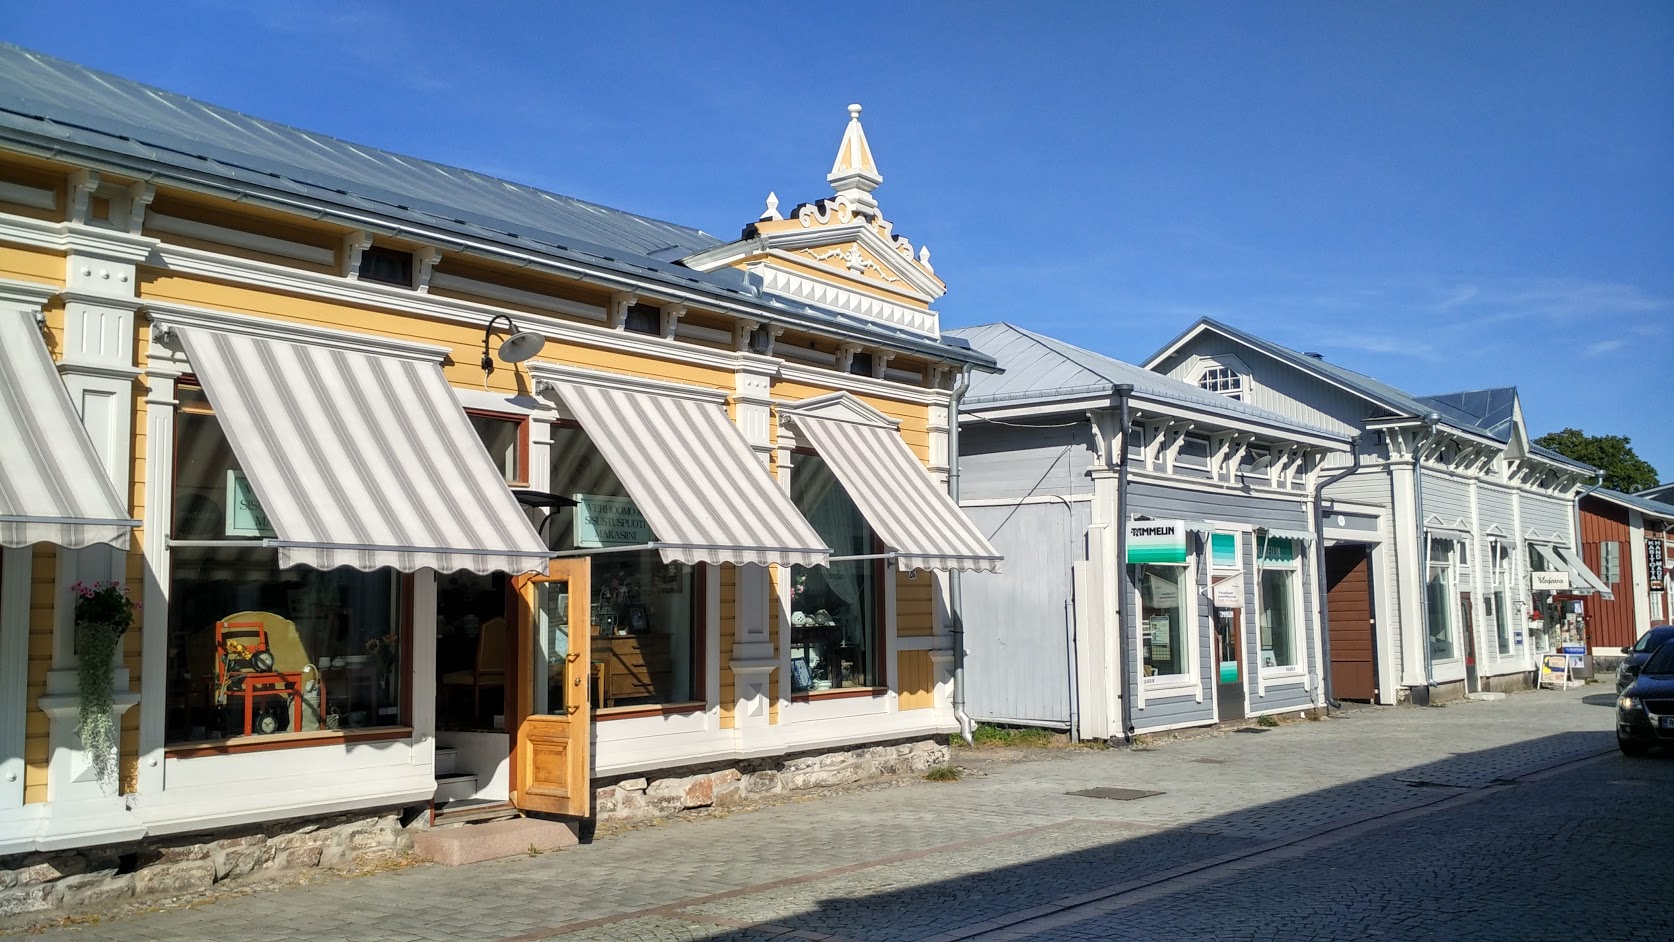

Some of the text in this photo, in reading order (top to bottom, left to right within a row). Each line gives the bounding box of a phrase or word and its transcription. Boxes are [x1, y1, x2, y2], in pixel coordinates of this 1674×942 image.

[587, 503, 635, 516] VERHOOMO
[595, 528, 637, 541] MAKASIINI
[1131, 527, 1174, 537] TAMMELIN
[1654, 541, 1662, 560] HAND
